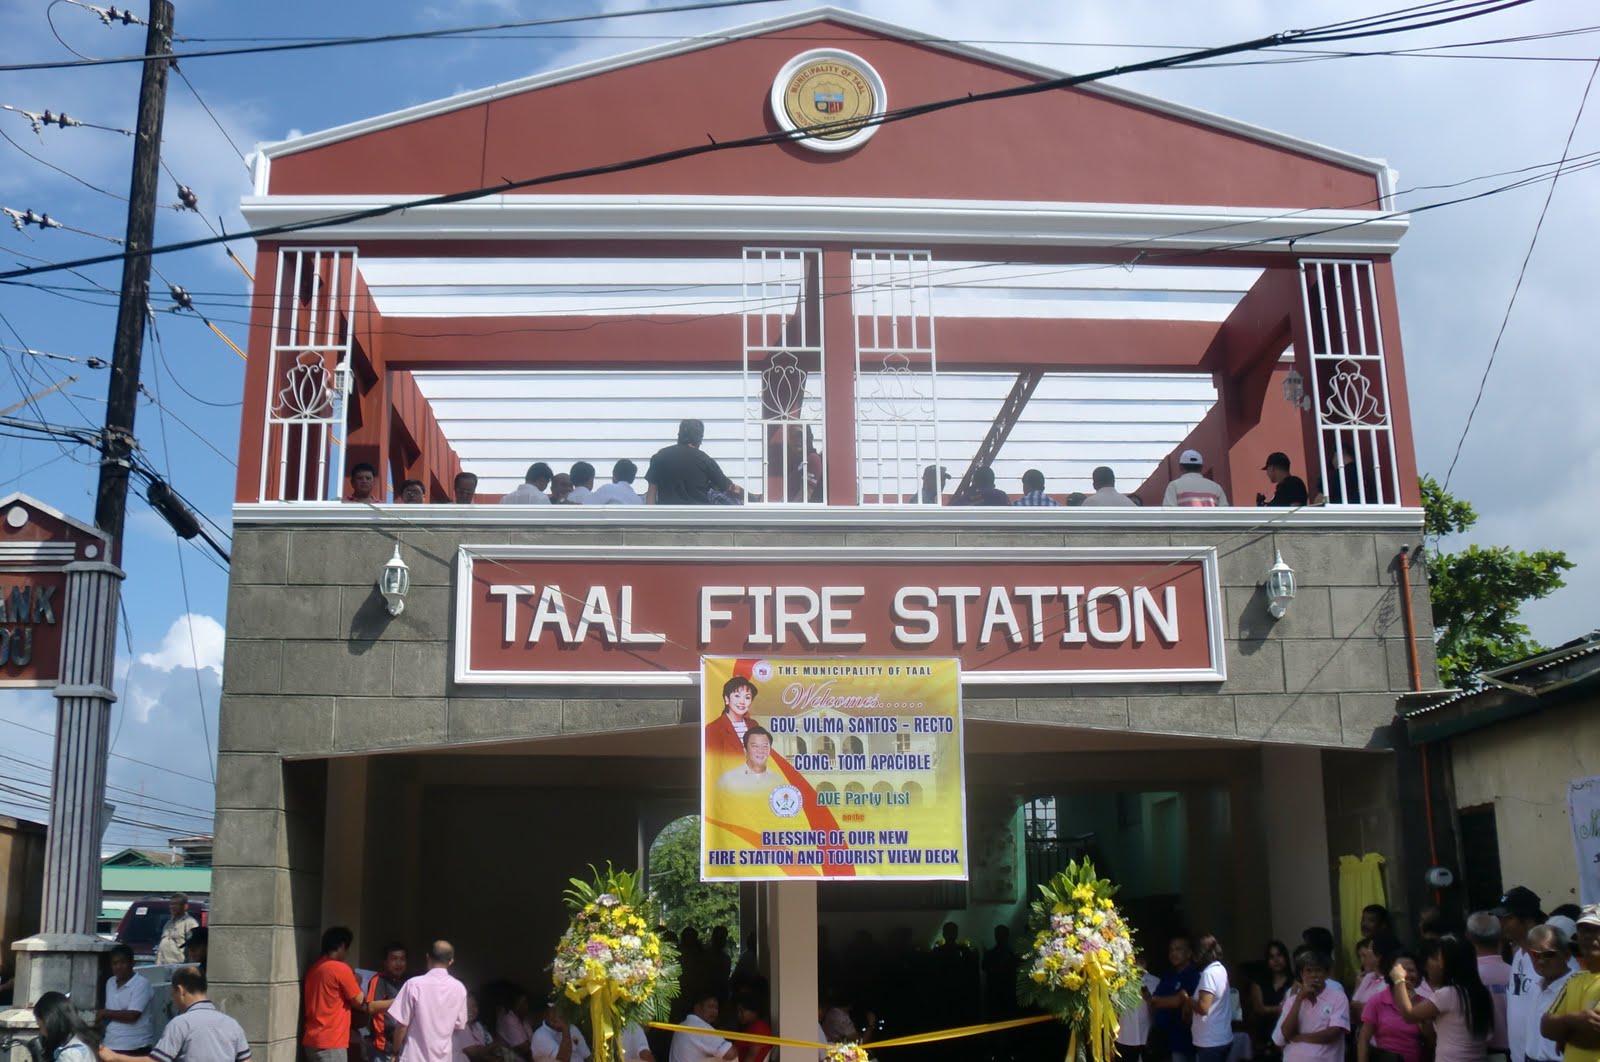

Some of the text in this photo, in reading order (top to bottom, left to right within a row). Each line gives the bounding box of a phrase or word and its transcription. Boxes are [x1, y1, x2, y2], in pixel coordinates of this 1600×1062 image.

[791, 65, 839, 94] MUNICIPALITY
[852, 77, 866, 94] TAAL
[489, 583, 1180, 646] TAAL FIRE STATION
[778, 667, 932, 675] THE MUNICIPALITY OF TAAL
[770, 717, 798, 732] GOV.
[803, 717, 844, 732] VILMA
[848, 717, 898, 732] SANTOS
[914, 717, 953, 732] RECTO
[794, 755, 931, 770] CONG. TOM APACIBLE
[817, 792, 840, 805] AVE
[845, 792, 882, 807] Party
[886, 791, 910, 805] List
[762, 831, 908, 846] BLESSING OF OUR NEW
[709, 850, 959, 865] FIRE STATION AND TOURIST VIEW DECK
